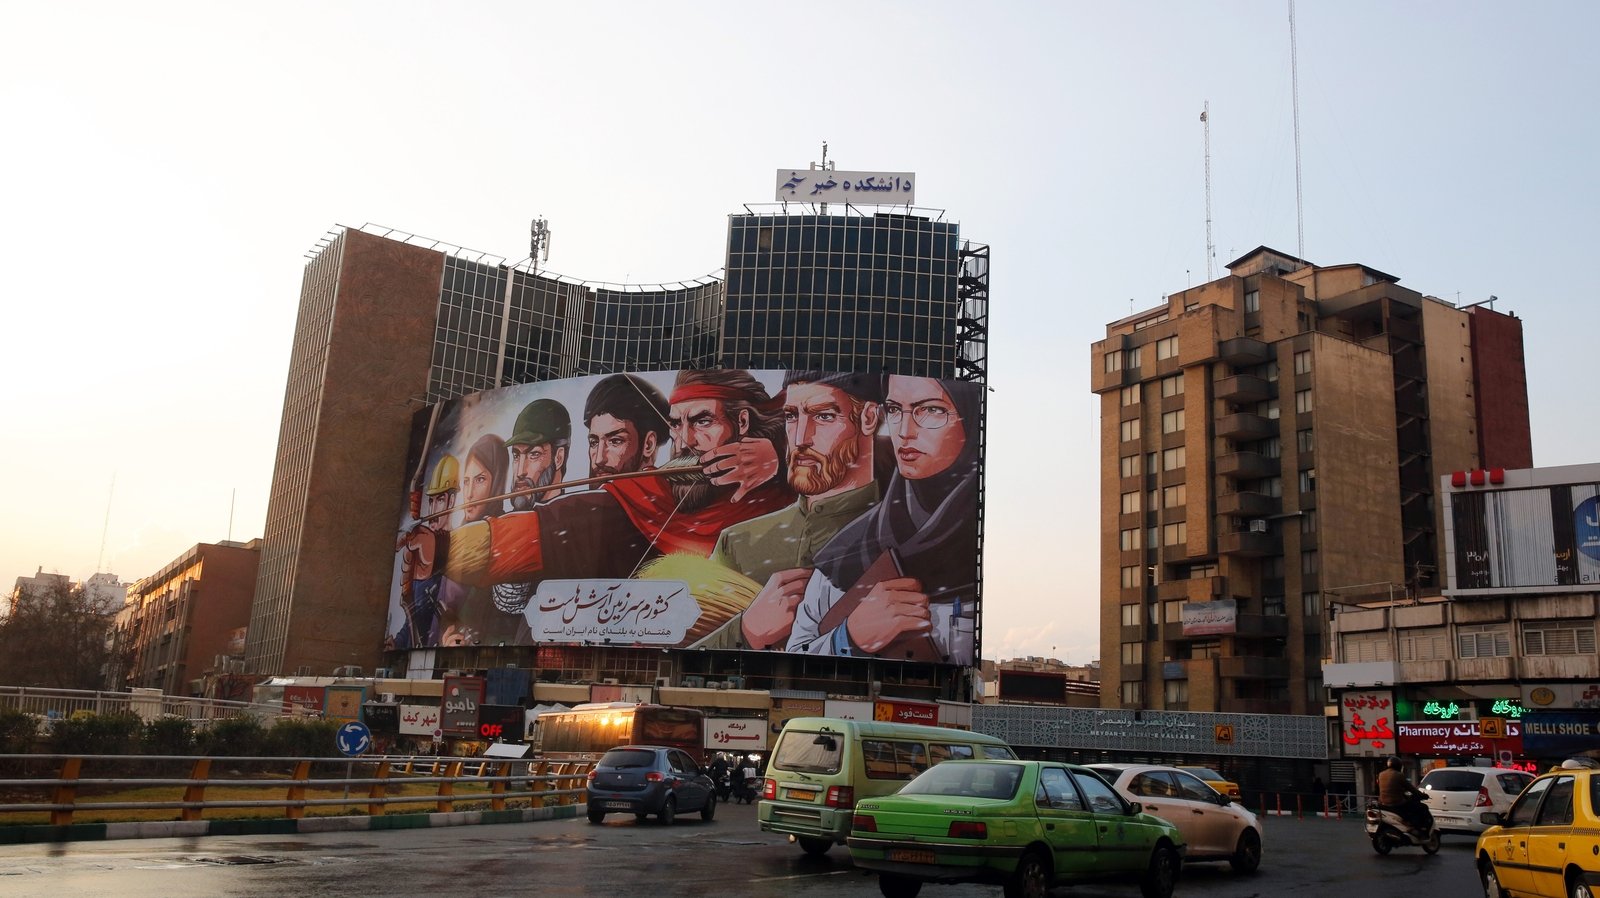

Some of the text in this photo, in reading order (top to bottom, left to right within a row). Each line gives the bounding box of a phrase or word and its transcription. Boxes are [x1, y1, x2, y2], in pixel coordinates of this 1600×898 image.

[810, 175, 912, 195] دانشکده خبر
[635, 587, 684, 624] کشورم
[566, 627, 588, 636] ایران
[588, 627, 598, 636] نام
[599, 627, 627, 637] بلندای
[629, 629, 636, 637] به
[445, 698, 476, 714] بامبو
[1423, 701, 1459, 719] داروخانه
[402, 711, 420, 725] کیف
[421, 713, 438, 726] شهر
[898, 708, 933, 719] فست فود
[480, 723, 504, 737] OFF
[728, 723, 746, 731] فروشگاه
[1166, 718, 1196, 730] میدان
[1525, 722, 1590, 736] MELLI SHOE
[713, 730, 760, 743] موزه
[1343, 713, 1394, 749] کیش
[1399, 725, 1450, 738] Pharmacy
[1432, 740, 1484, 751] دکتر علی هوشمند
